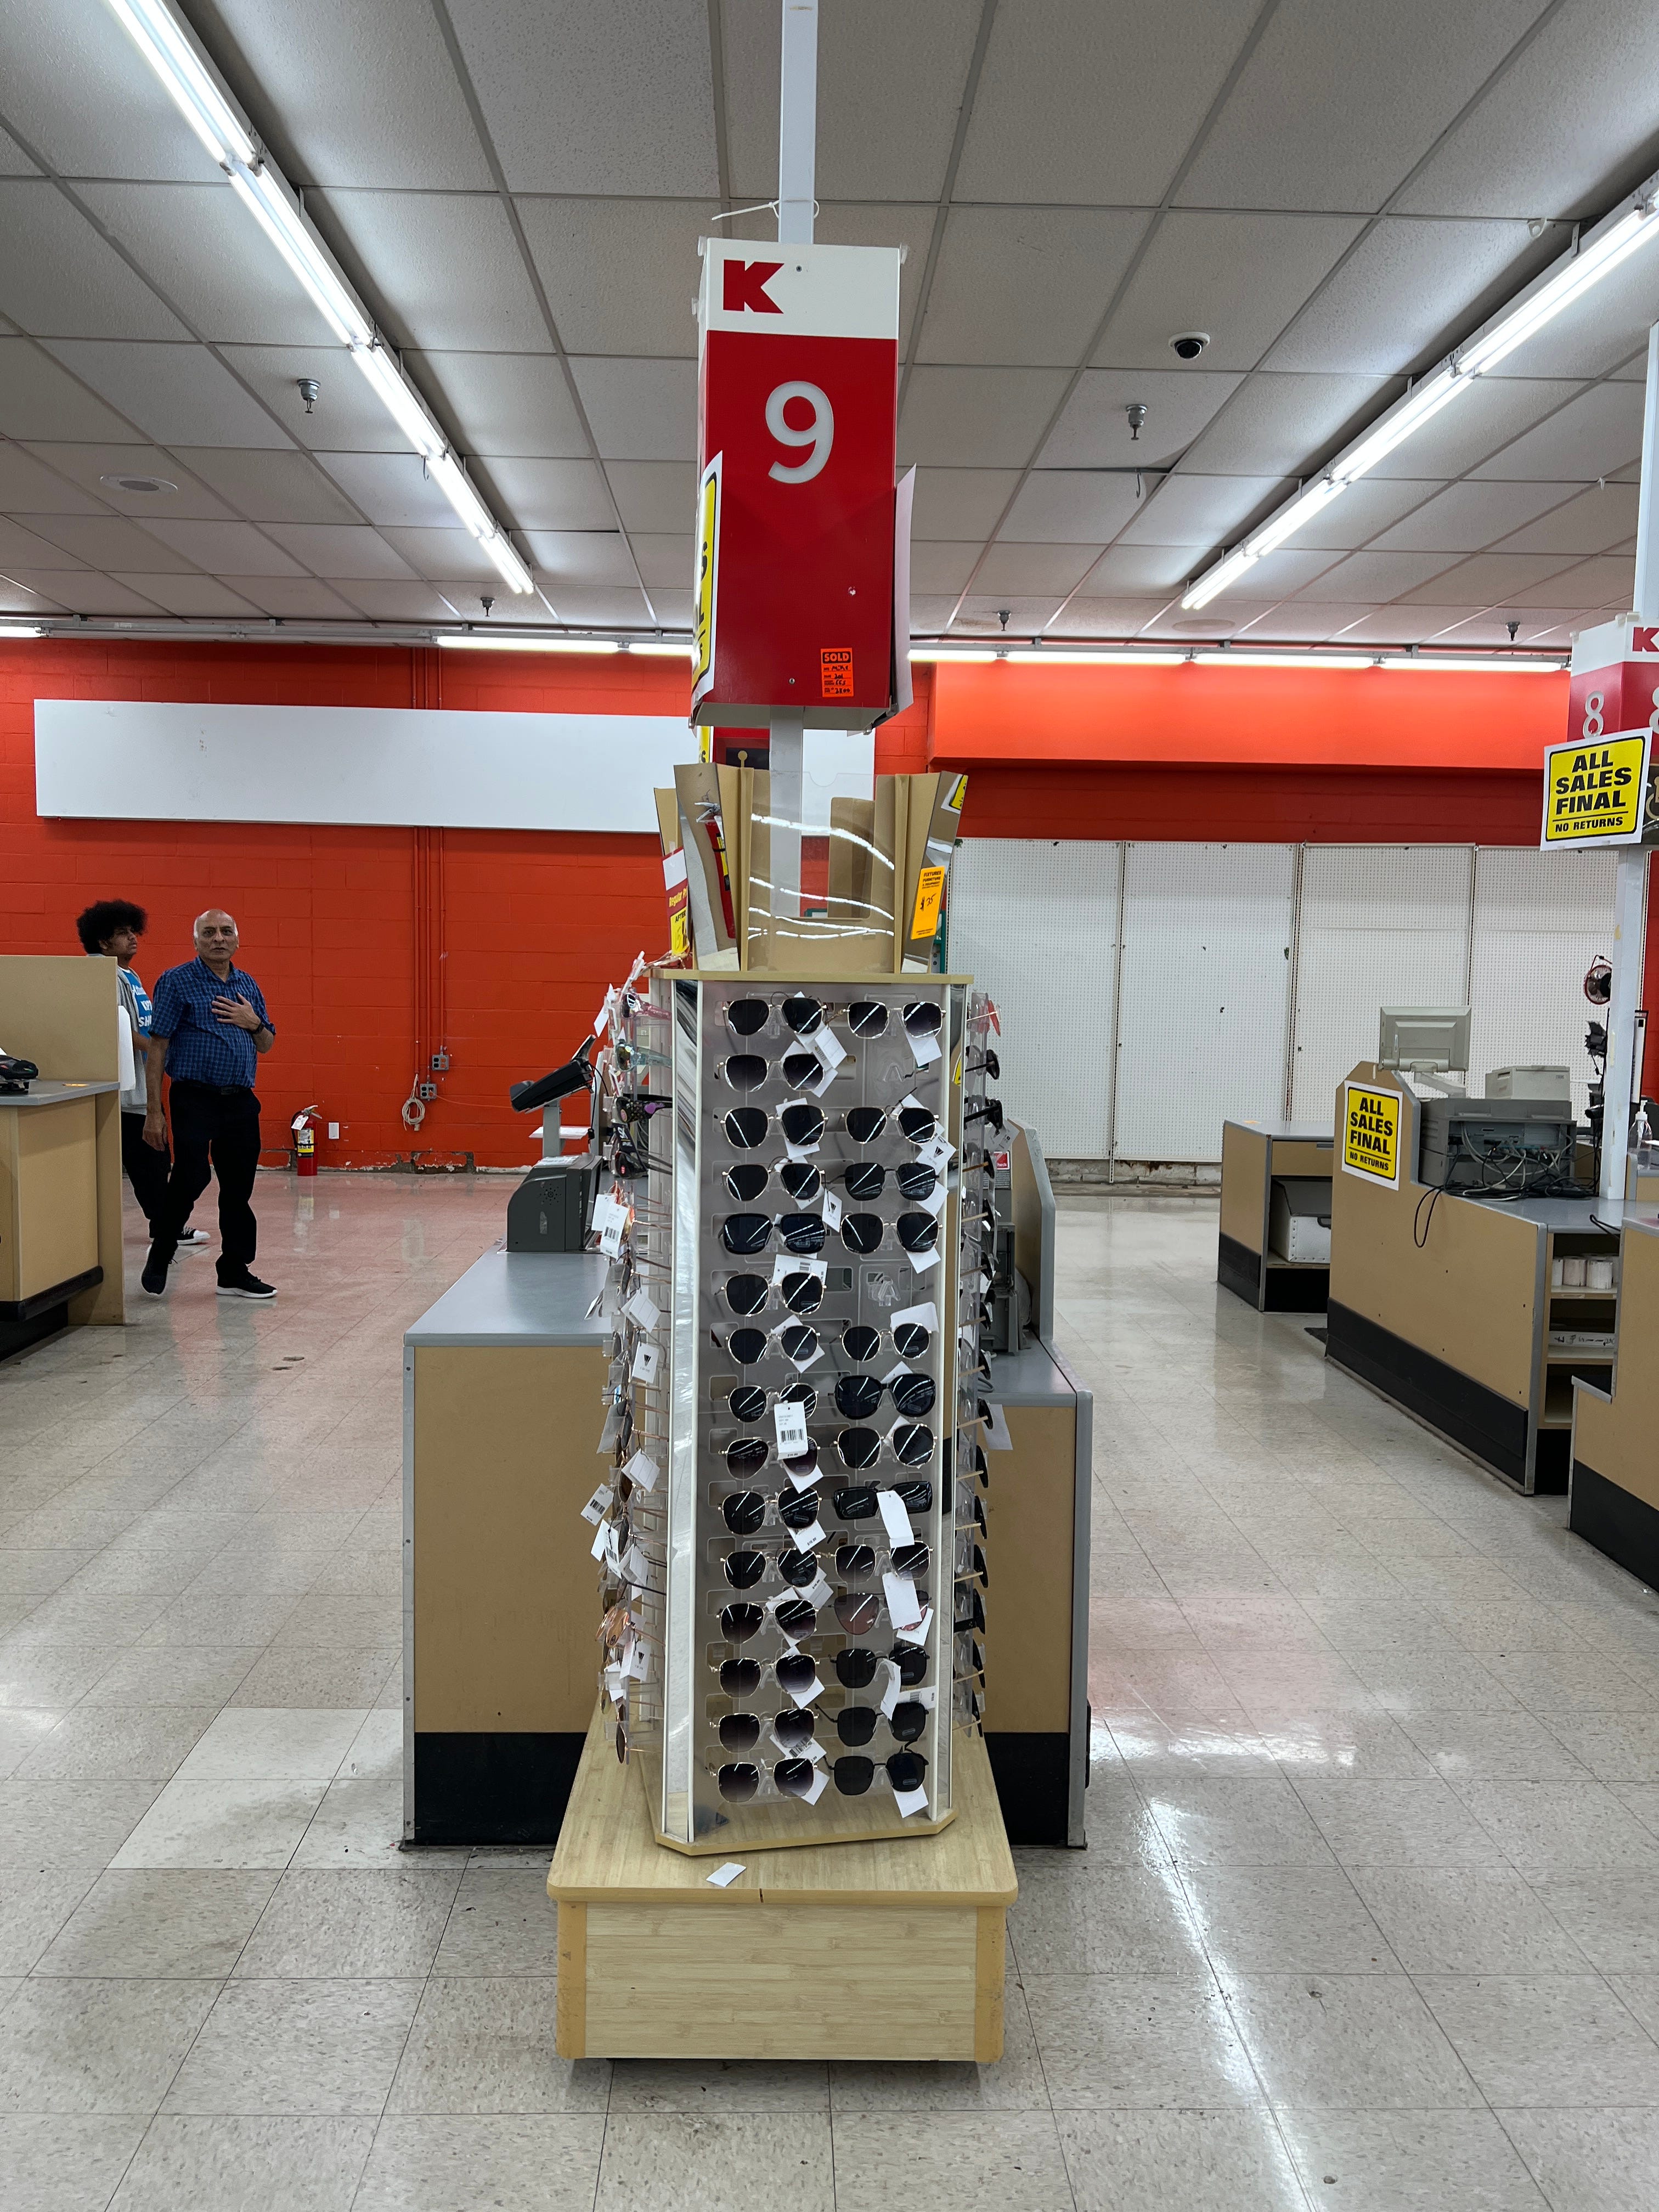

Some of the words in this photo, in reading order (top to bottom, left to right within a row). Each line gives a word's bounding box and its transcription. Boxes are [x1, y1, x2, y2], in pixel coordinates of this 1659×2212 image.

[723, 259, 785, 314] K
[765, 381, 834, 484] 9
[824, 652, 849, 662] SOLD
[1583, 691, 1604, 738] 8
[1572, 750, 1613, 773] ALL
[1556, 767, 1632, 794] SALES
[1556, 790, 1626, 815] FINAL
[1555, 823, 1568, 832] NO
[1573, 816, 1623, 831] RETURNS
[1359, 1097, 1384, 1117] ALL
[1350, 1111, 1393, 1137] SALES
[1350, 1129, 1390, 1155] FINAL
[1350, 1151, 1358, 1161] NO
[1360, 1154, 1389, 1171] RETURNS
